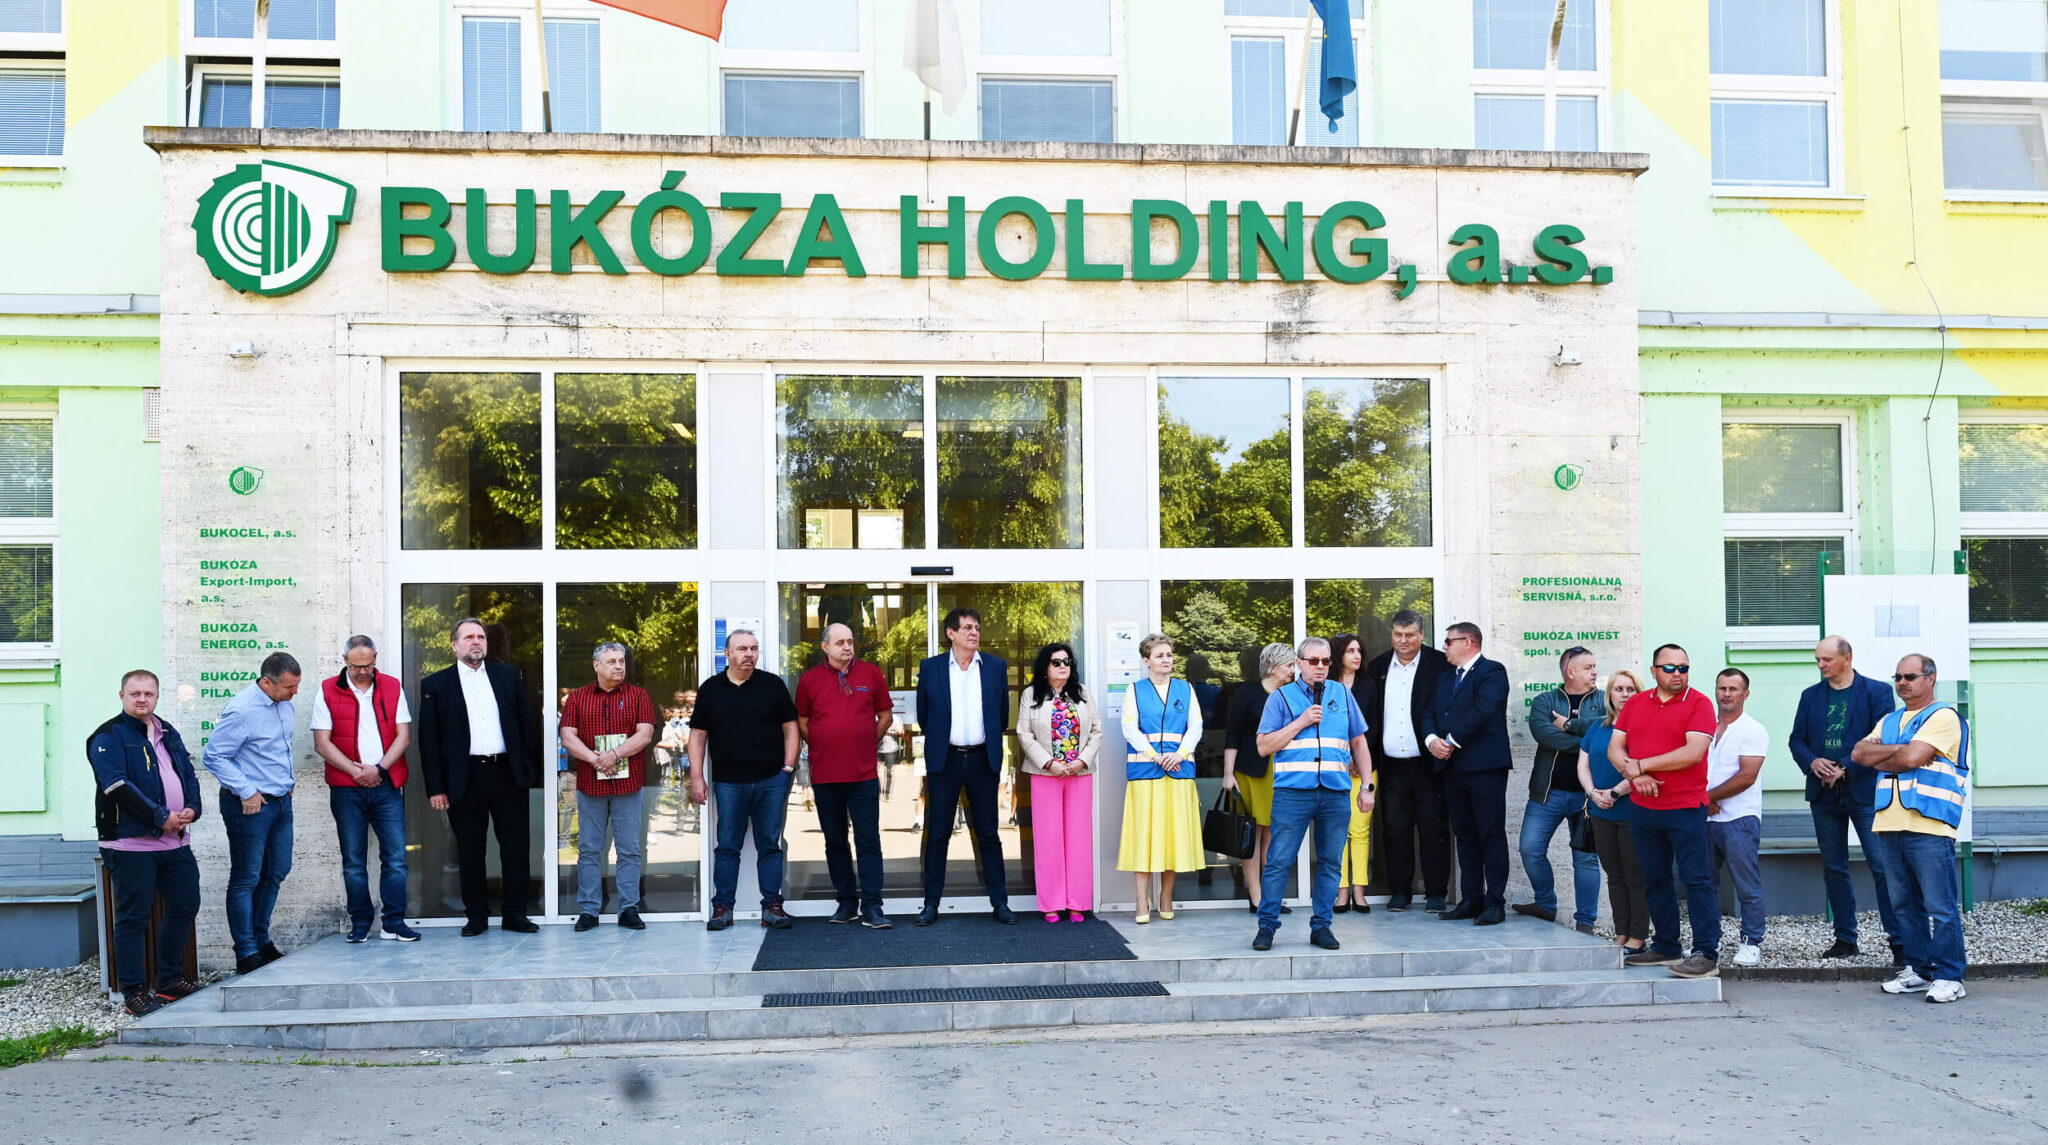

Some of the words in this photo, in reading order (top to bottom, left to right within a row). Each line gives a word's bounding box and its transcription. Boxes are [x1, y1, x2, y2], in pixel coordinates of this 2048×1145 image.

[381, 170, 867, 278] BUKÓZA
[899, 194, 1418, 299] HOLDING,
[1447, 222, 1614, 286] a.s.
[200, 528, 269, 539] BUKOCEL,
[273, 530, 296, 538] a.s.
[200, 576, 297, 588] Export-Import,
[200, 595, 225, 603] a.s.
[200, 621, 258, 633] BUKÓZA
[1576, 630, 1620, 641] INVEST
[200, 639, 261, 651] ENERGO,
[265, 641, 289, 649] a.s.
[1523, 647, 1551, 658] spol.
[1554, 648, 1561, 656] s
[200, 669, 258, 682] BUKÓZA
